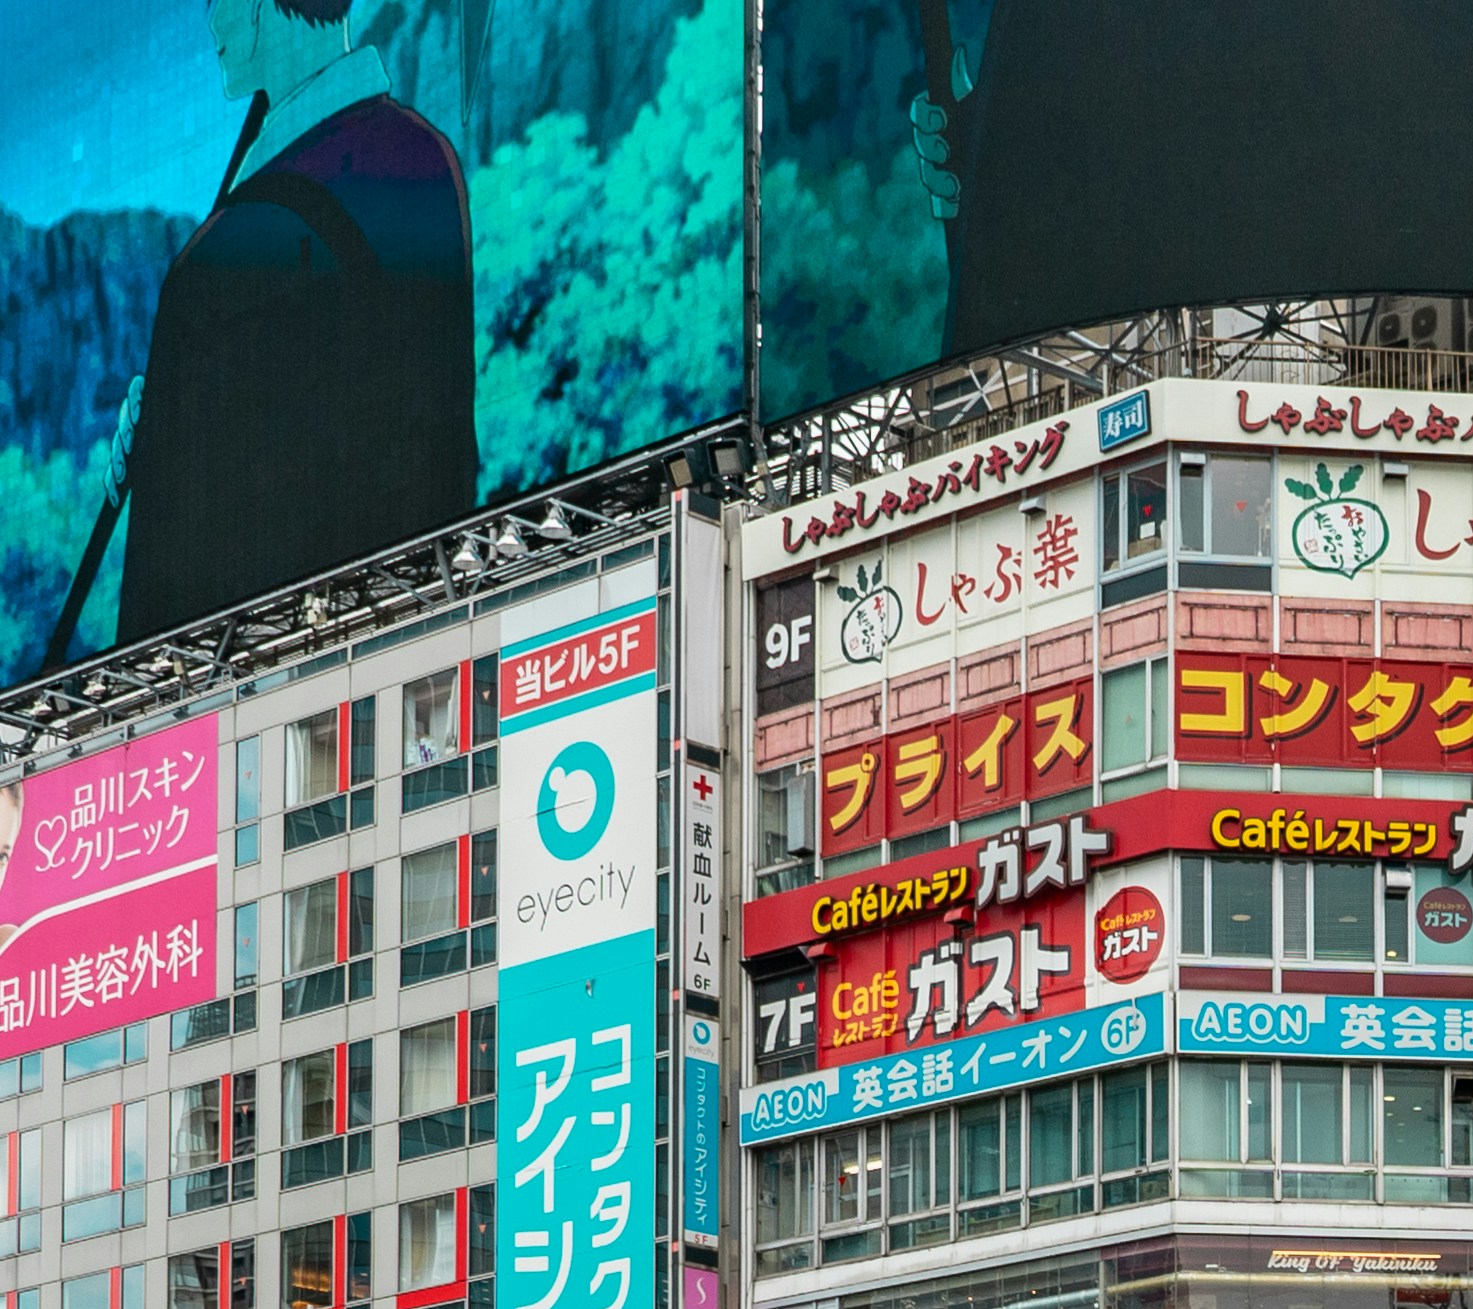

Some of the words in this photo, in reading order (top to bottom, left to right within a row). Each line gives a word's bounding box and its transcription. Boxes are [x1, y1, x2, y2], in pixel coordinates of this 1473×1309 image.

[1102, 399, 1144, 443] 寿司
[782, 420, 1071, 554] しゃぶしゃぶバイキング
[917, 515, 1081, 627] しゃぶ葉
[516, 625, 641, 706] 当ビル5F
[766, 614, 814, 671] 9F
[71, 749, 208, 828] 品川スキン
[826, 693, 1086, 831] プライス
[70, 805, 190, 882] クリニック
[977, 815, 1111, 908] ガスト
[517, 863, 636, 932] eyecity
[693, 821, 713, 967] 献血ルーム
[1424, 911, 1468, 928] ガスト
[1102, 929, 1159, 961] ガスト
[694, 973, 712, 991] 6F
[832, 969, 899, 1018] Café
[907, 929, 1069, 1042] ガスト
[760, 992, 816, 1053] 7F
[833, 1013, 898, 1048] レストラン
[1199, 1005, 1305, 1039] AEON
[754, 1082, 827, 1127] AEON
[852, 1027, 1088, 1114] 英会話イーオン
[1106, 1011, 1143, 1051] 6F
[694, 1233, 710, 1247] 5F
[1267, 1252, 1310, 1272] King
